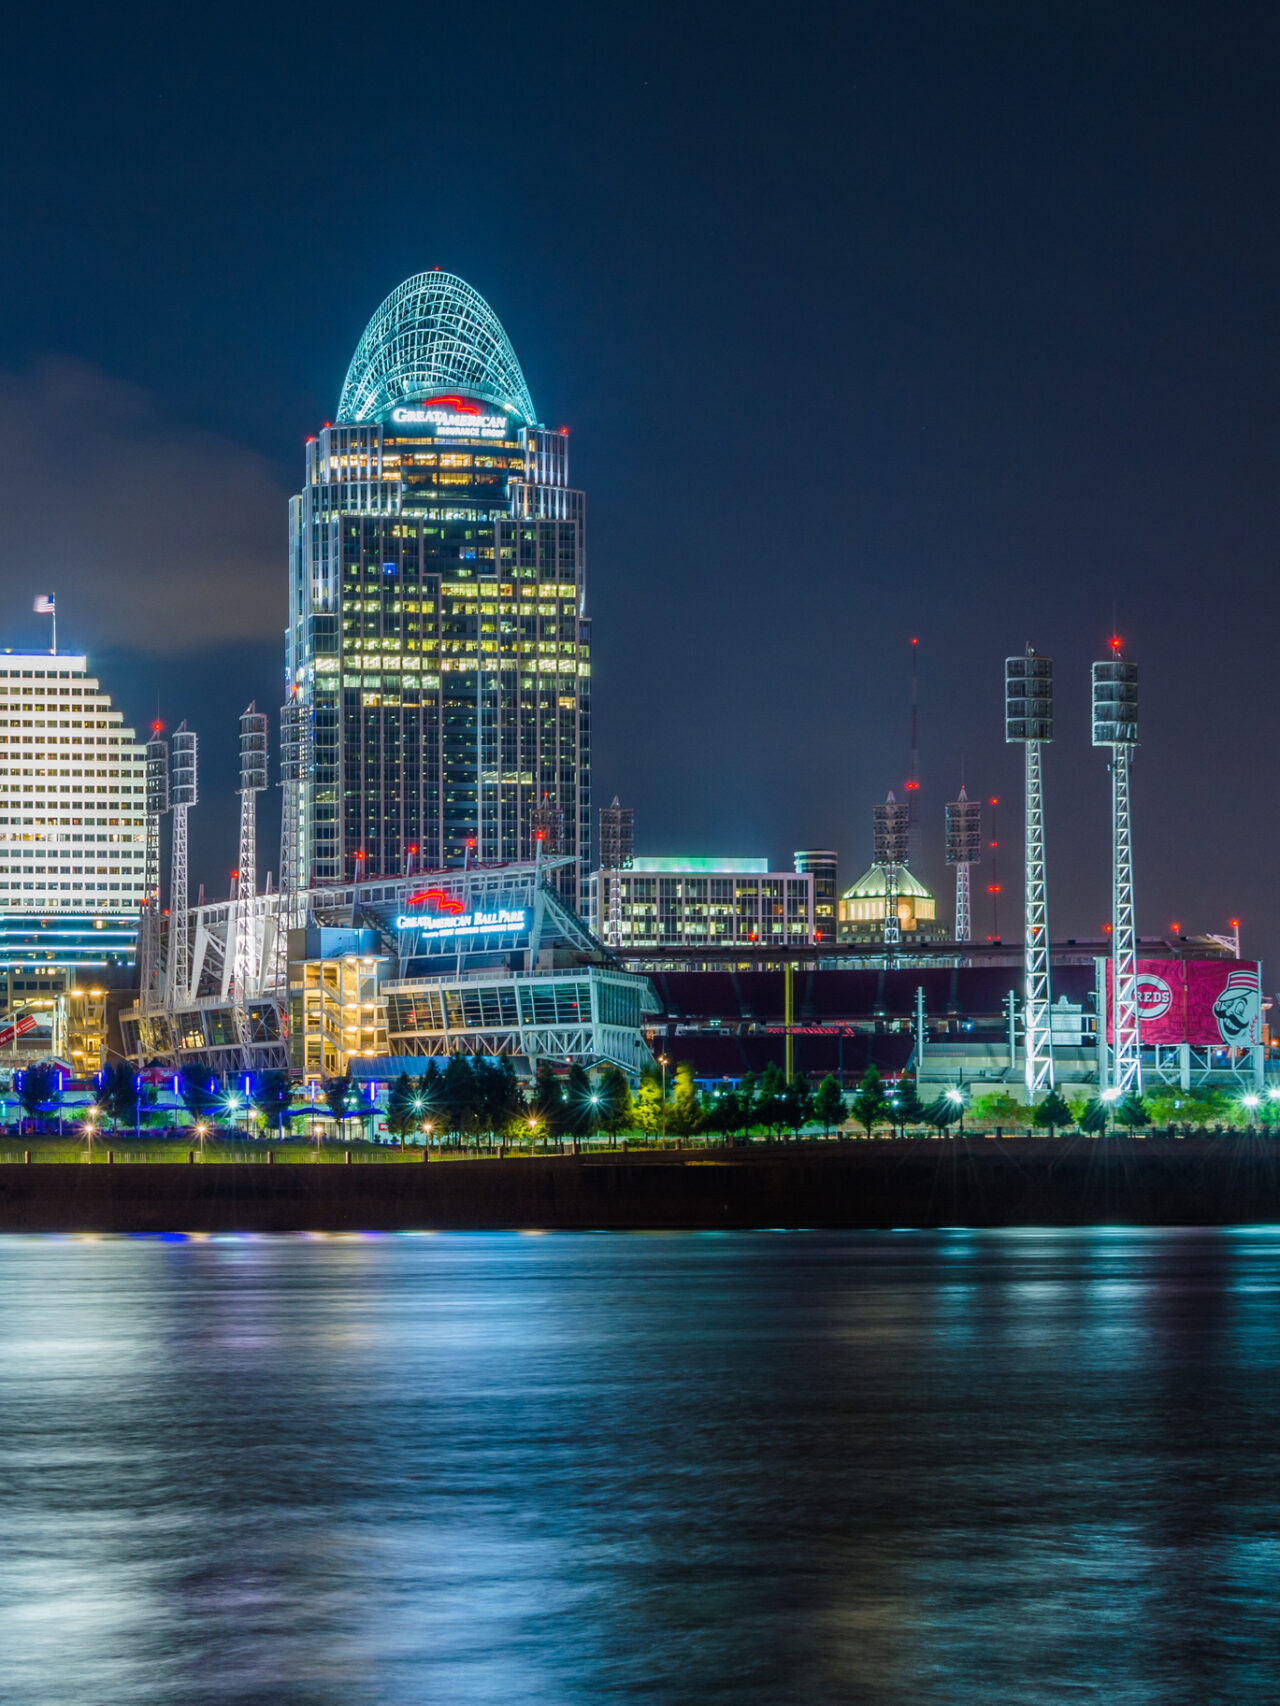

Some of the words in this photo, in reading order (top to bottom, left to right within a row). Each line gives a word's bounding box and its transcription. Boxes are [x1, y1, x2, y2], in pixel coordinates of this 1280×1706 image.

[393, 408, 440, 422] GREAT
[436, 412, 507, 428] AMERICAN
[397, 915, 429, 929] GREAT
[424, 915, 472, 930] AMERICAN
[474, 911, 498, 926] BALL
[498, 909, 525, 923] PARK
[1134, 991, 1170, 1003] REDS
